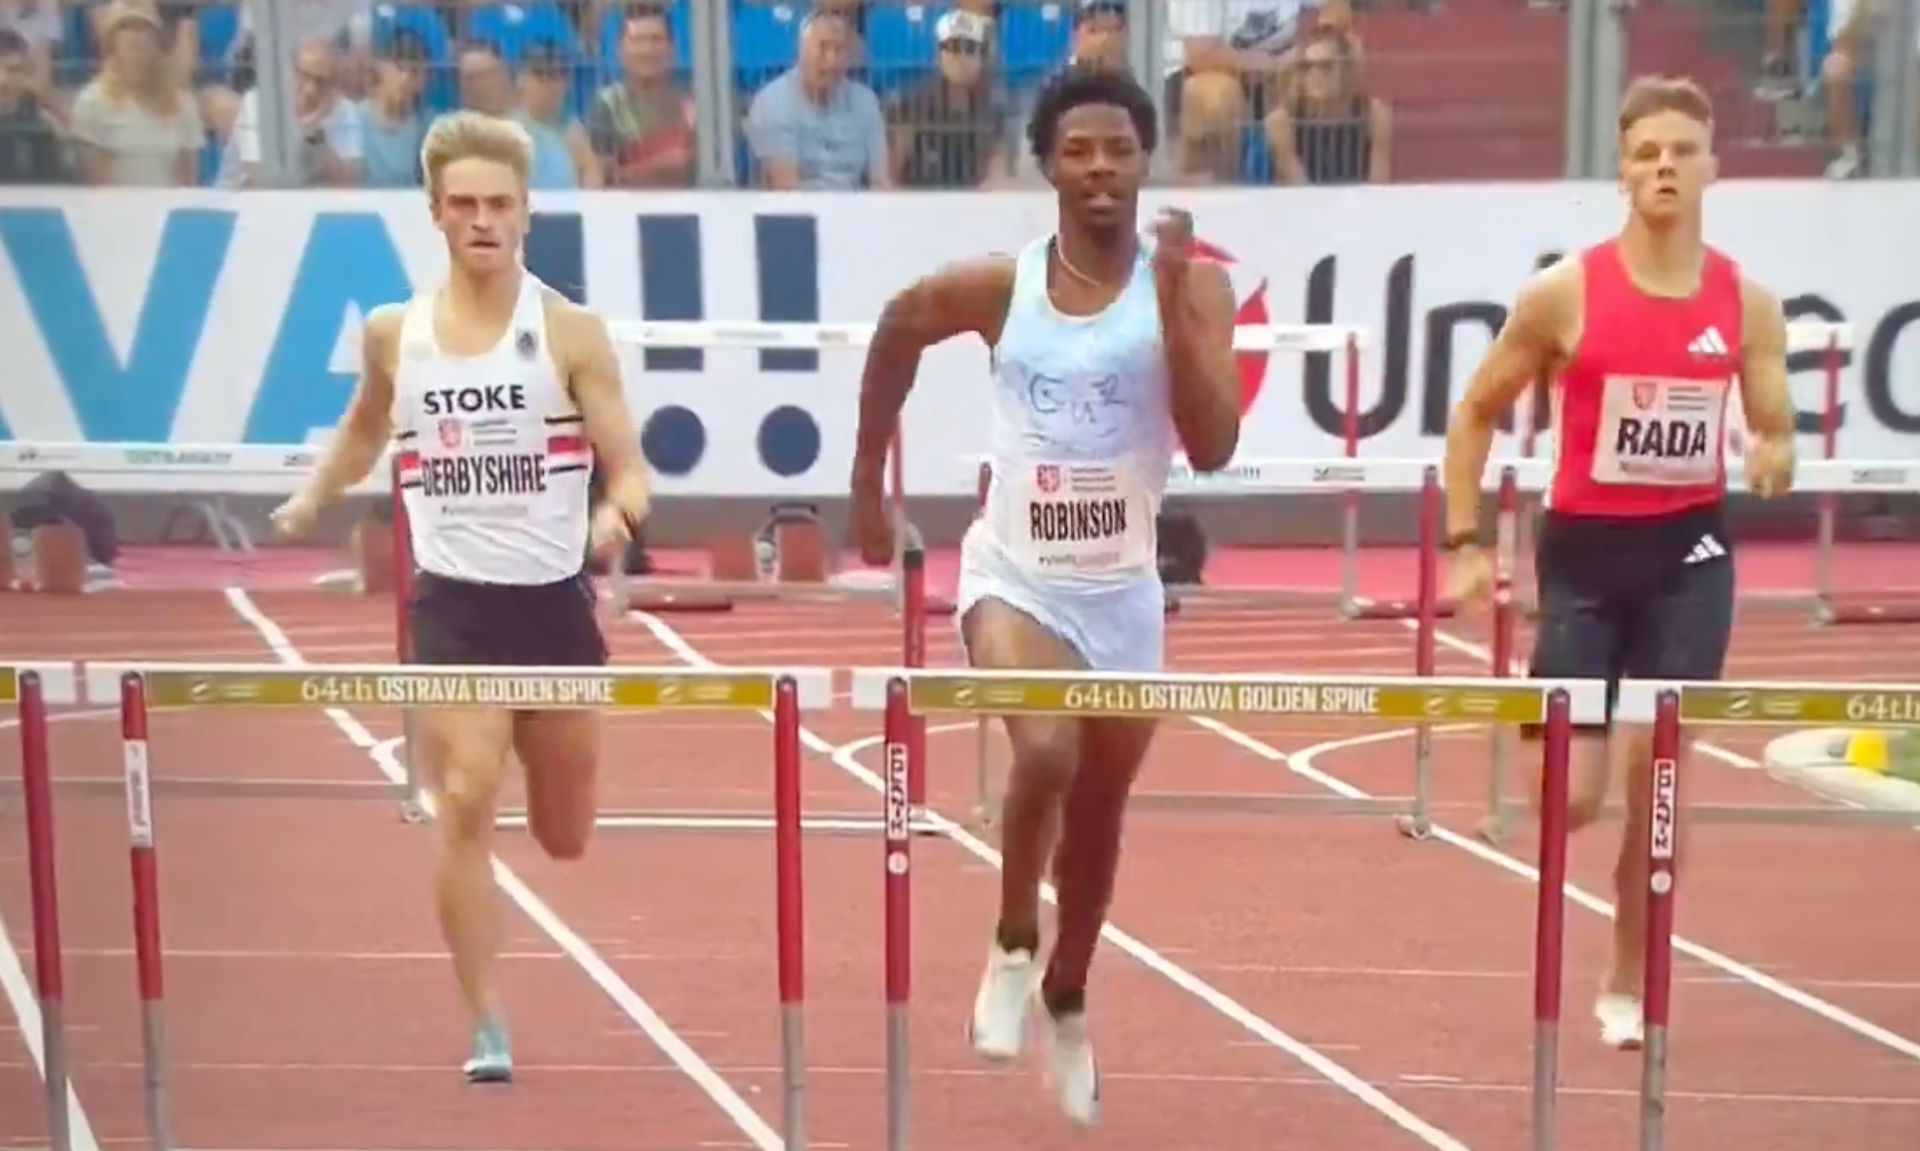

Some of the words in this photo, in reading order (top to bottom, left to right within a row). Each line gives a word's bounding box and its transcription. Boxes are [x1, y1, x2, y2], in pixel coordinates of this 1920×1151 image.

[423, 384, 526, 415] STOKE
[1616, 416, 1706, 458] RADA
[422, 454, 547, 498] DERBYSHIRE
[1029, 498, 1127, 543] ROBINSON
[301, 676, 374, 702] 64th
[377, 675, 471, 704] OSTRAVA
[475, 676, 553, 704] GOLDEN
[557, 677, 614, 704] SPIKE
[1065, 683, 1135, 710] 64th
[1139, 683, 1234, 712] OSTRAVA
[1238, 685, 1317, 713] GOLDEN
[1321, 686, 1380, 714] SPIKE
